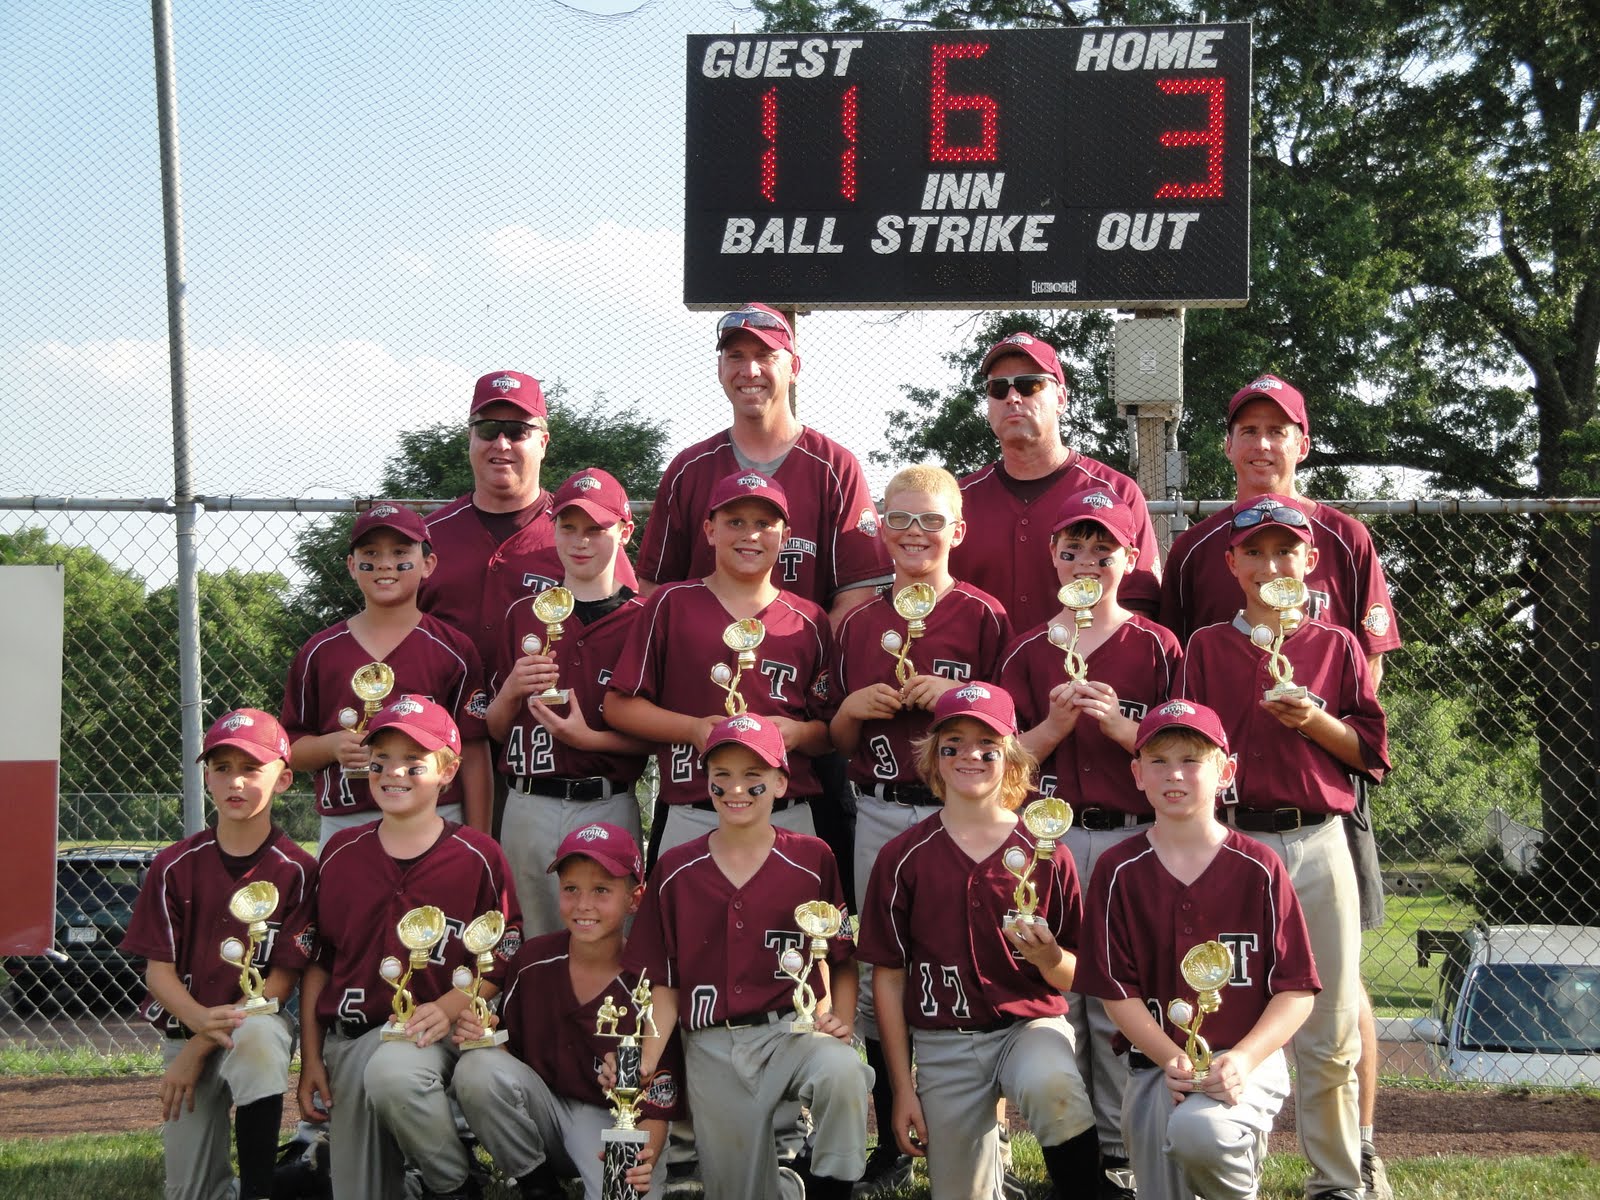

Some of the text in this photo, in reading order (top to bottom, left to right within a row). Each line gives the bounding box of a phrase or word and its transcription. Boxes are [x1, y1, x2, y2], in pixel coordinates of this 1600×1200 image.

[702, 39, 864, 79] GUEST
[1075, 30, 1225, 71] HOME
[930, 43, 998, 162] 6
[1156, 78, 1226, 199] 3
[921, 173, 1006, 210] INN
[720, 217, 844, 255] BALL
[870, 213, 1055, 254] STRIKE
[1096, 211, 1200, 251] OUT
[492, 378, 521, 389] TITAN
[1251, 380, 1283, 390] TITAN
[779, 552, 803, 582] T
[760, 659, 798, 703] T
[956, 686, 991, 699] TITAN
[221, 715, 254, 729] TITAN
[391, 701, 424, 714] TITAN
[728, 718, 761, 732] TITAN
[1160, 703, 1196, 716] TITAN
[507, 725, 556, 776] 42
[870, 735, 899, 780] 3
[577, 826, 609, 840] TITANS
[765, 930, 805, 980] T
[1218, 933, 1259, 987] T
[337, 988, 368, 1024] 5
[920, 963, 972, 1019] 17
